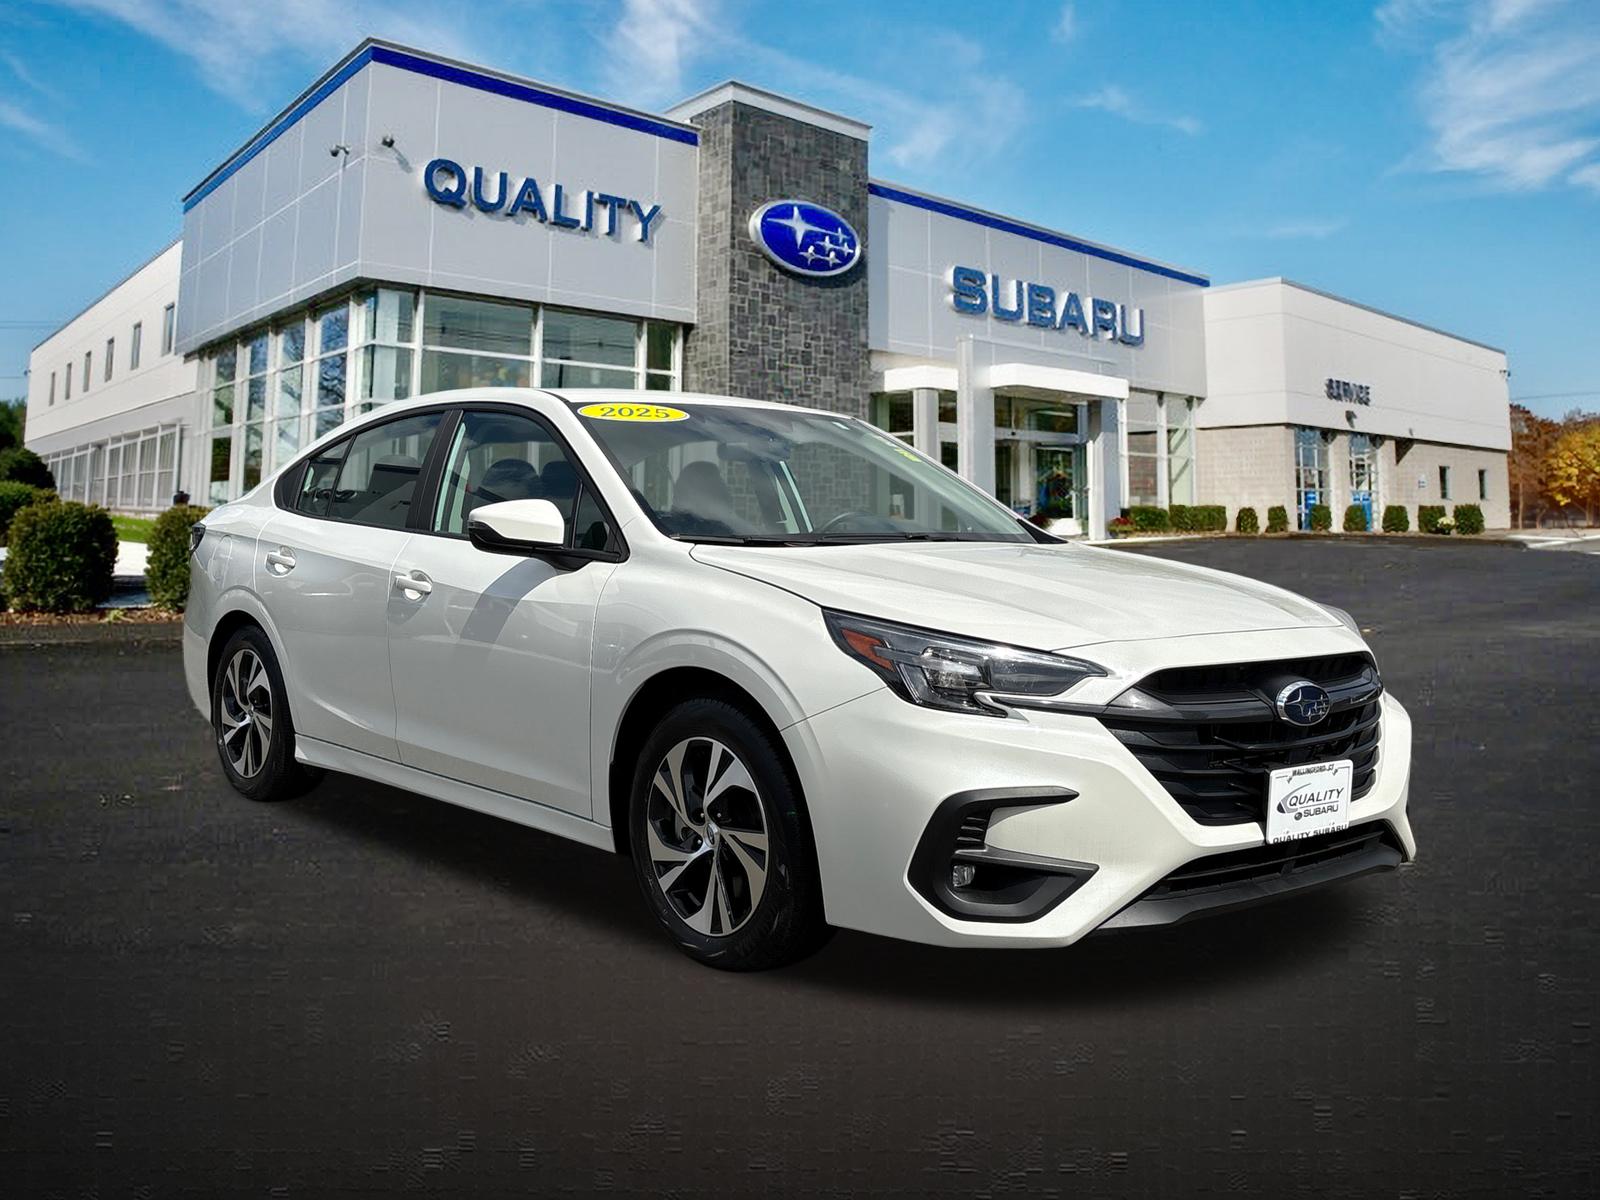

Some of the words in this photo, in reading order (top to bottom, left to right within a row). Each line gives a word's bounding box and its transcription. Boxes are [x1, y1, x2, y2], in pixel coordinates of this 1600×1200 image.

[423, 158, 662, 242] QUALITY
[951, 265, 1145, 347] SUBARU
[1324, 378, 1370, 406] SERVICE
[599, 406, 670, 418] 2025
[1289, 787, 1344, 807] QUALITY
[1303, 804, 1339, 817] SUBARU
[1273, 831, 1310, 843] QUALITY
[1313, 824, 1347, 836] SUBARU
